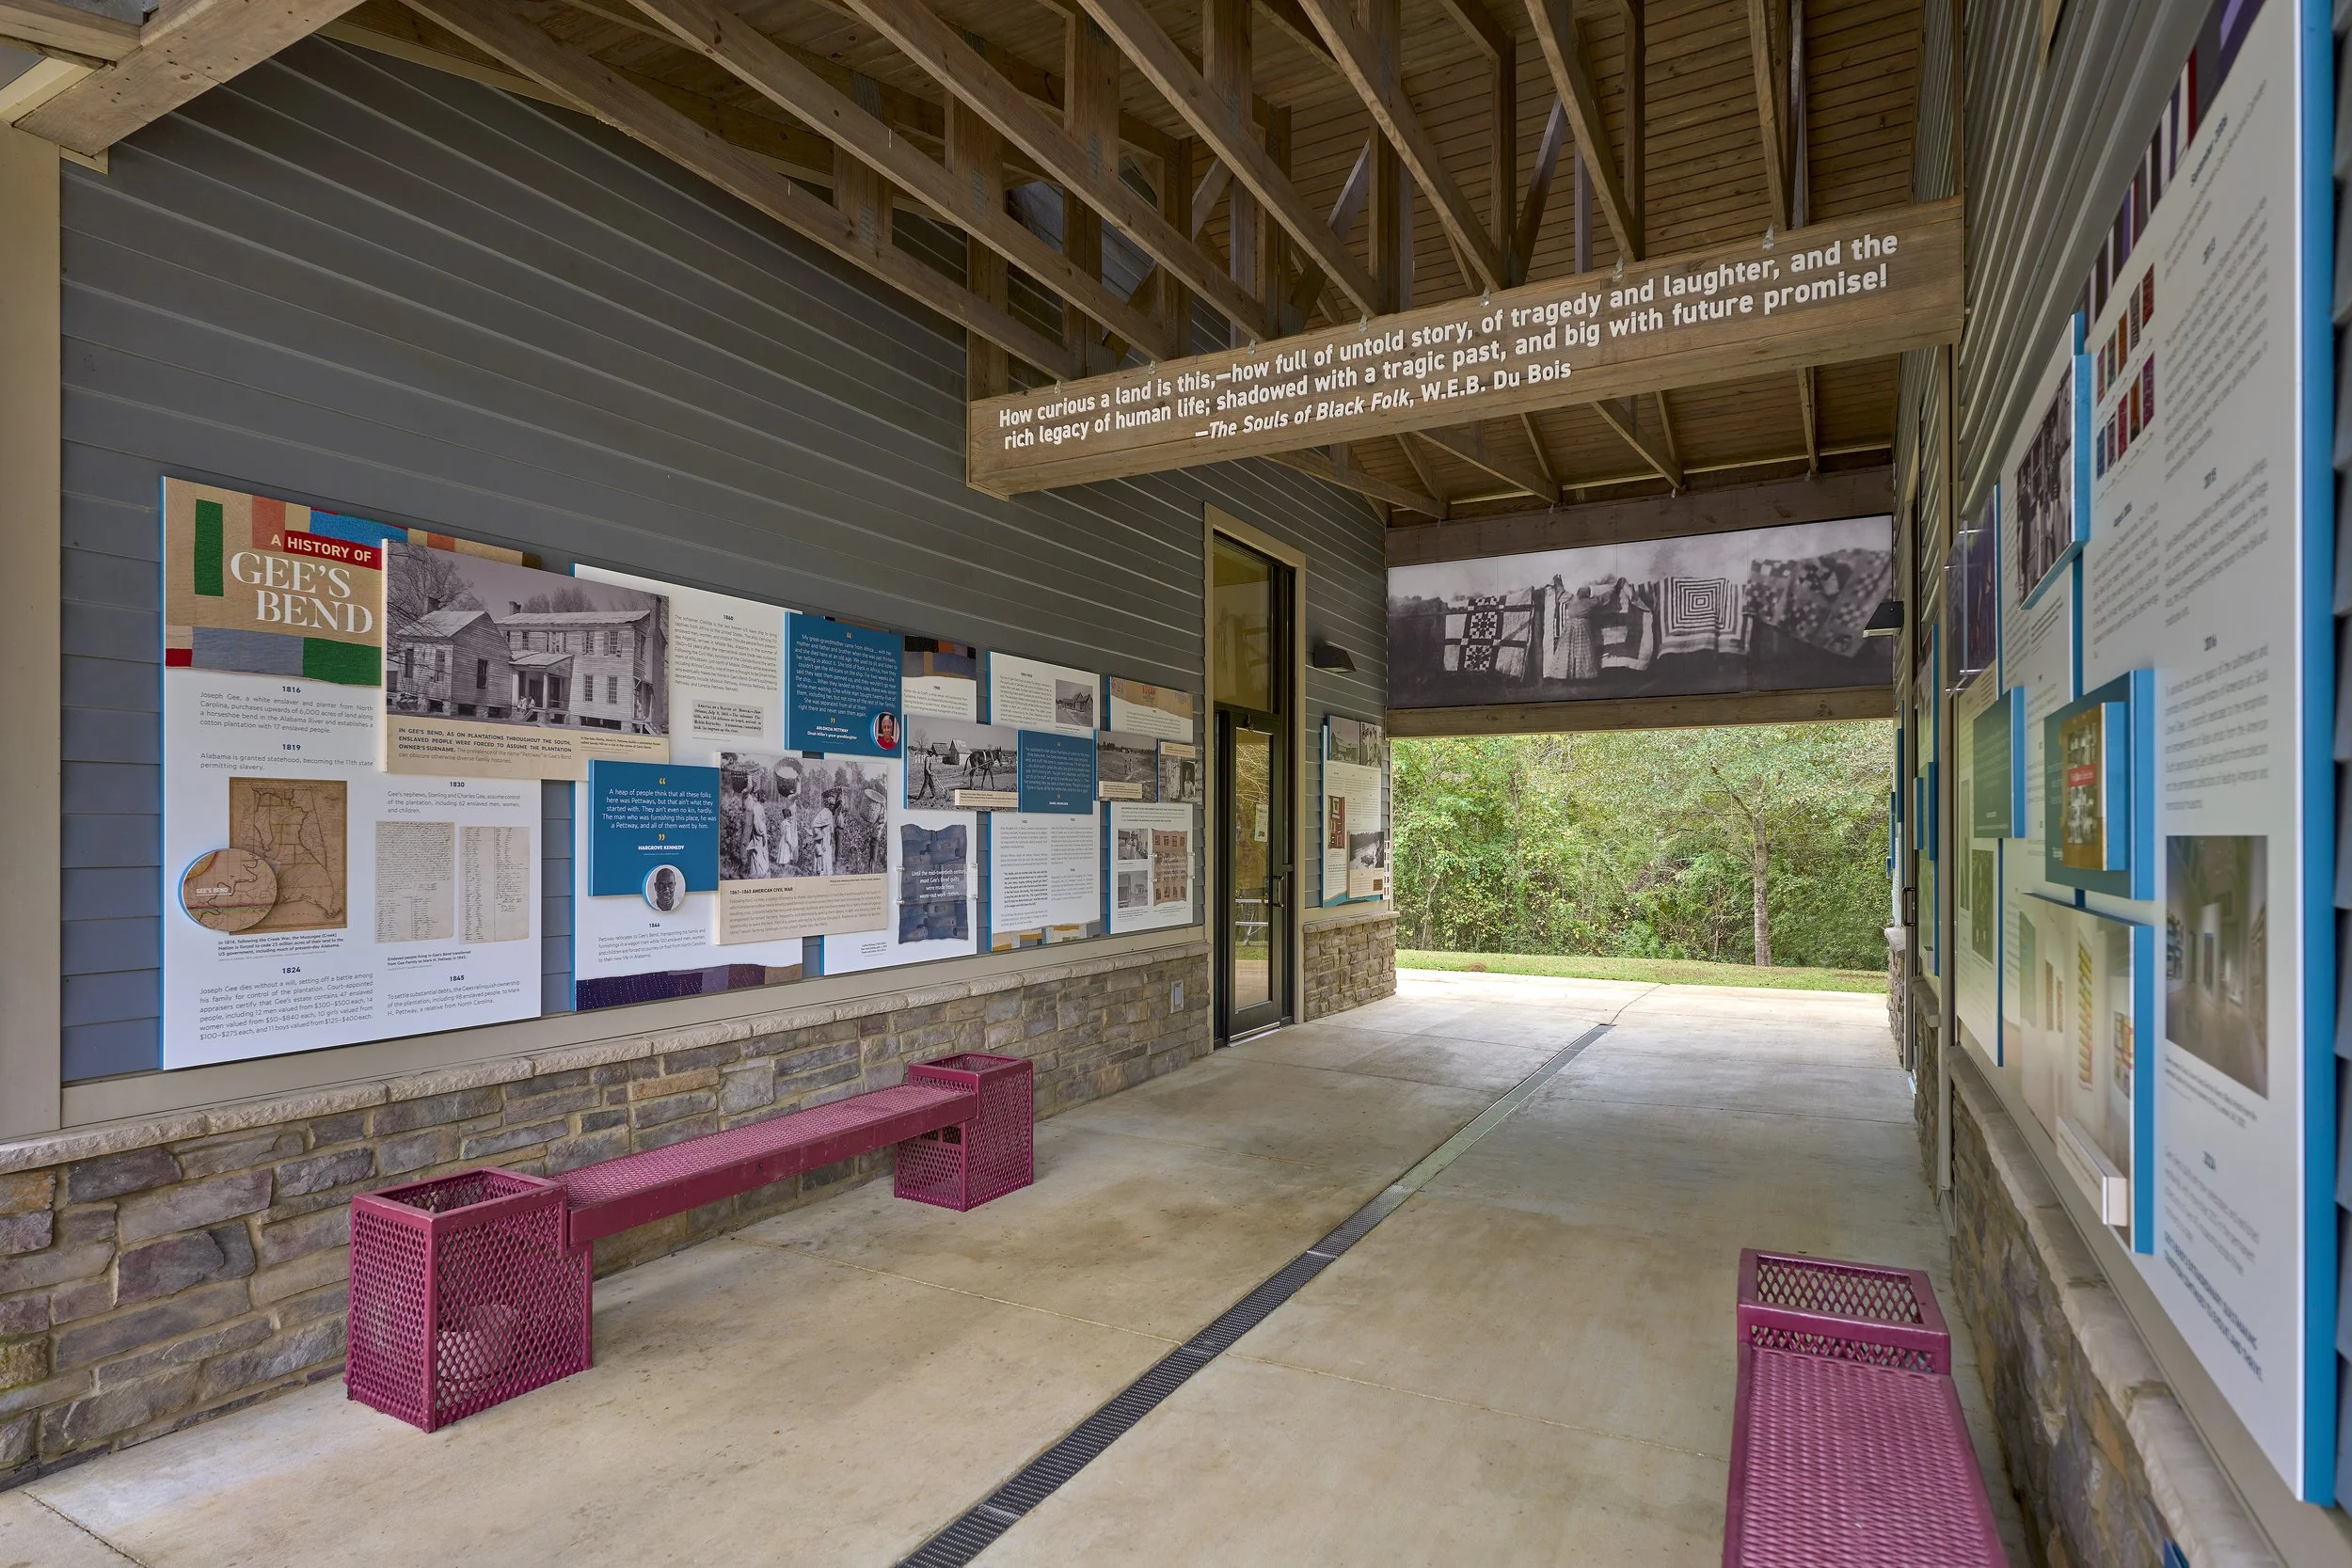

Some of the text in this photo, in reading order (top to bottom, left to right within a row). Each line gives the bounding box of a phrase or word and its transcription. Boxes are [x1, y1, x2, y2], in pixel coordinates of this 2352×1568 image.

[999, 409, 1033, 427] How
[1038, 394, 1095, 420] curious
[1101, 392, 1109, 407] a
[1116, 381, 1152, 405] land
[1157, 378, 1171, 397] is
[1276, 349, 1307, 374] full
[1313, 344, 1333, 367] of
[1340, 330, 1404, 361] untold
[1411, 320, 1473, 347] story,
[1482, 309, 1503, 333] of
[1511, 292, 1601, 328] tragedy
[1610, 278, 1654, 309] and
[1663, 259, 1780, 297] laughter,
[1790, 241, 1841, 273] and
[1851, 234, 1898, 260] the
[1004, 262, 1887, 450] rich legacy of human life; shadowed with a tragic past, and big with future promise!
[1242, 409, 1288, 435] Souls
[1294, 404, 1312, 425] of
[1316, 396, 1365, 421] Black
[1371, 388, 1415, 412] Folk,
[1421, 375, 1486, 403] W.E.B.
[1493, 370, 1520, 390] Du
[1528, 360, 1571, 385] Bois
[270, 533, 372, 562] A HISTORY OF
[230, 551, 351, 599] GEE'S
[256, 589, 373, 634] BEND
[199, 700, 230, 709] Carolina,
[282, 686, 301, 694] 1816
[206, 709, 240, 719] horseshoe
[223, 720, 256, 728] plantation
[309, 725, 331, 734] people.
